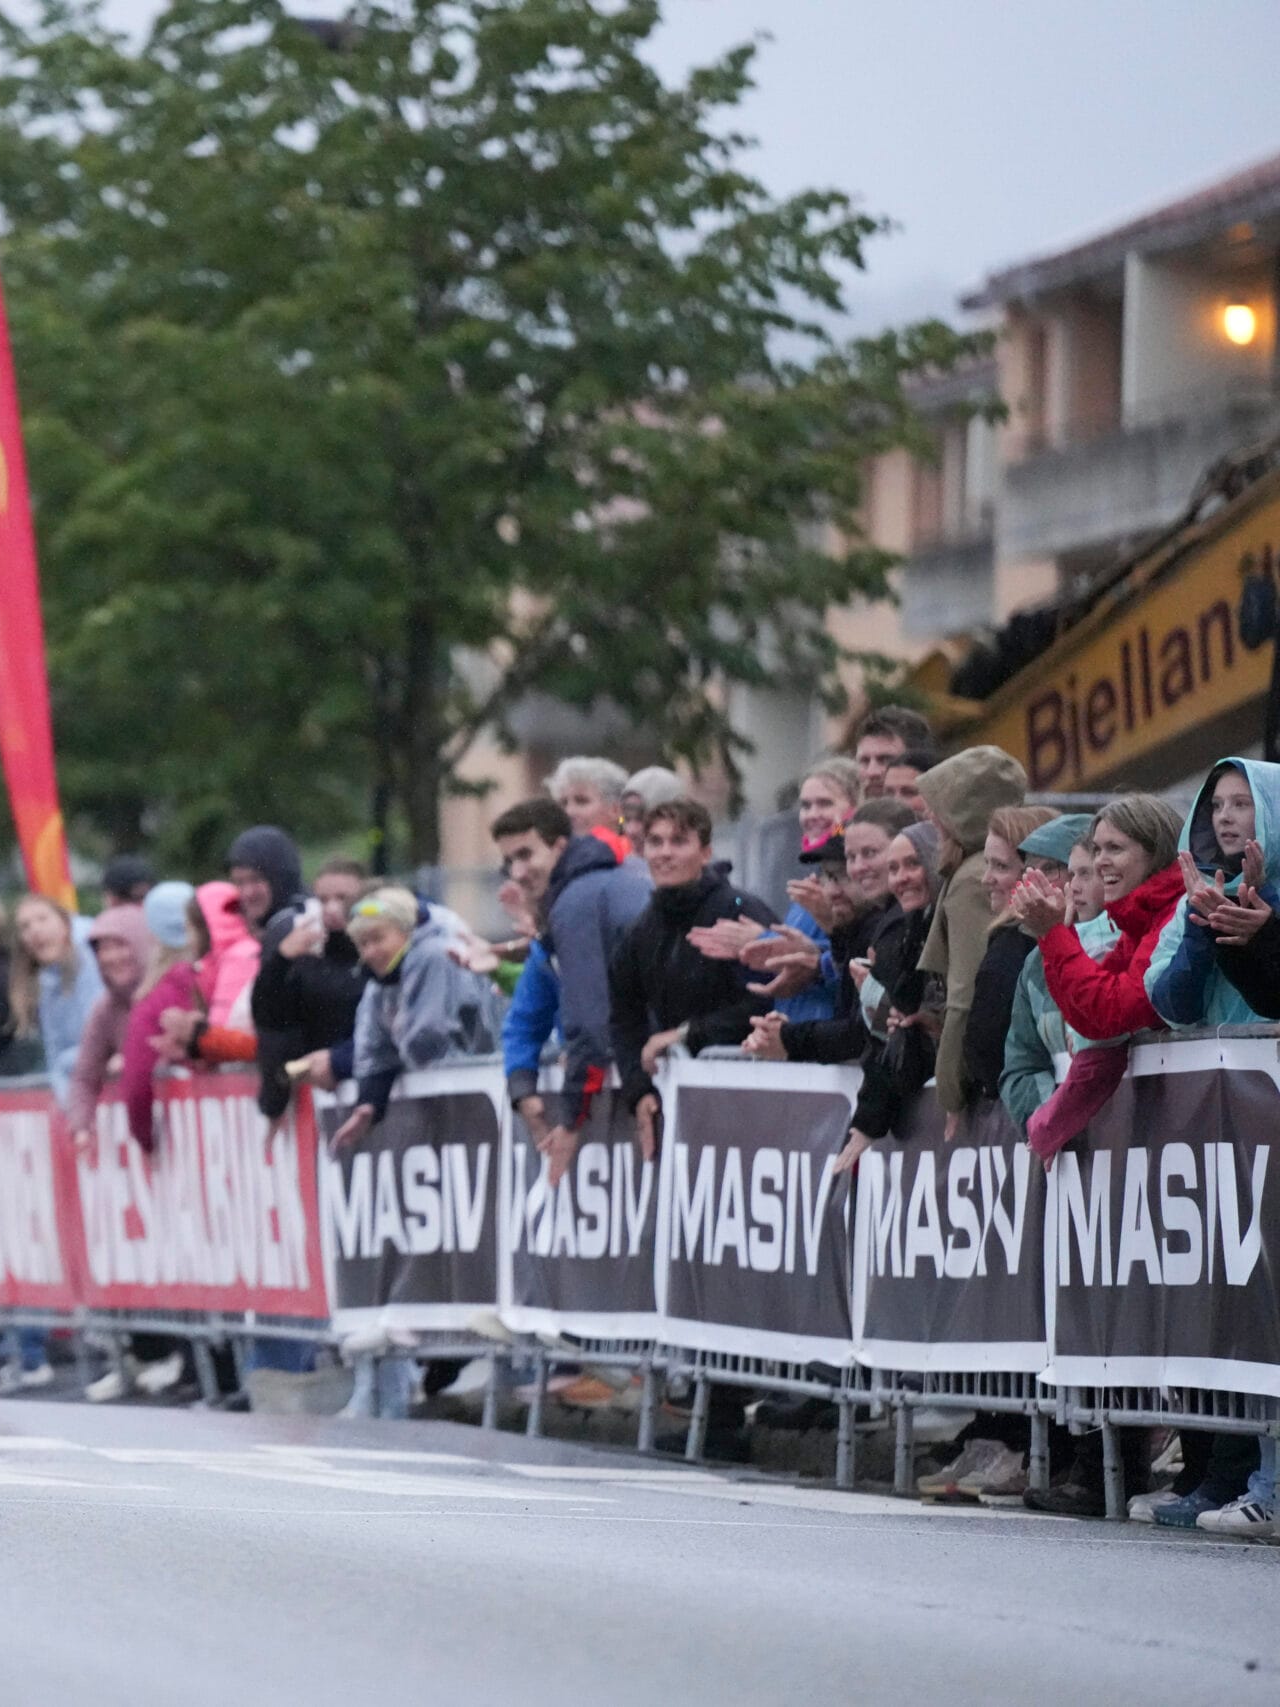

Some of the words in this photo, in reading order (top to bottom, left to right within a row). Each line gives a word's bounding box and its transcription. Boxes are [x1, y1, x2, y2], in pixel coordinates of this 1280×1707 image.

[1026, 543, 1273, 790] Bjellan
[325, 1142, 492, 1260] MASIV
[670, 1143, 838, 1277] MASIV
[1058, 1142, 1270, 1287] MASIV
